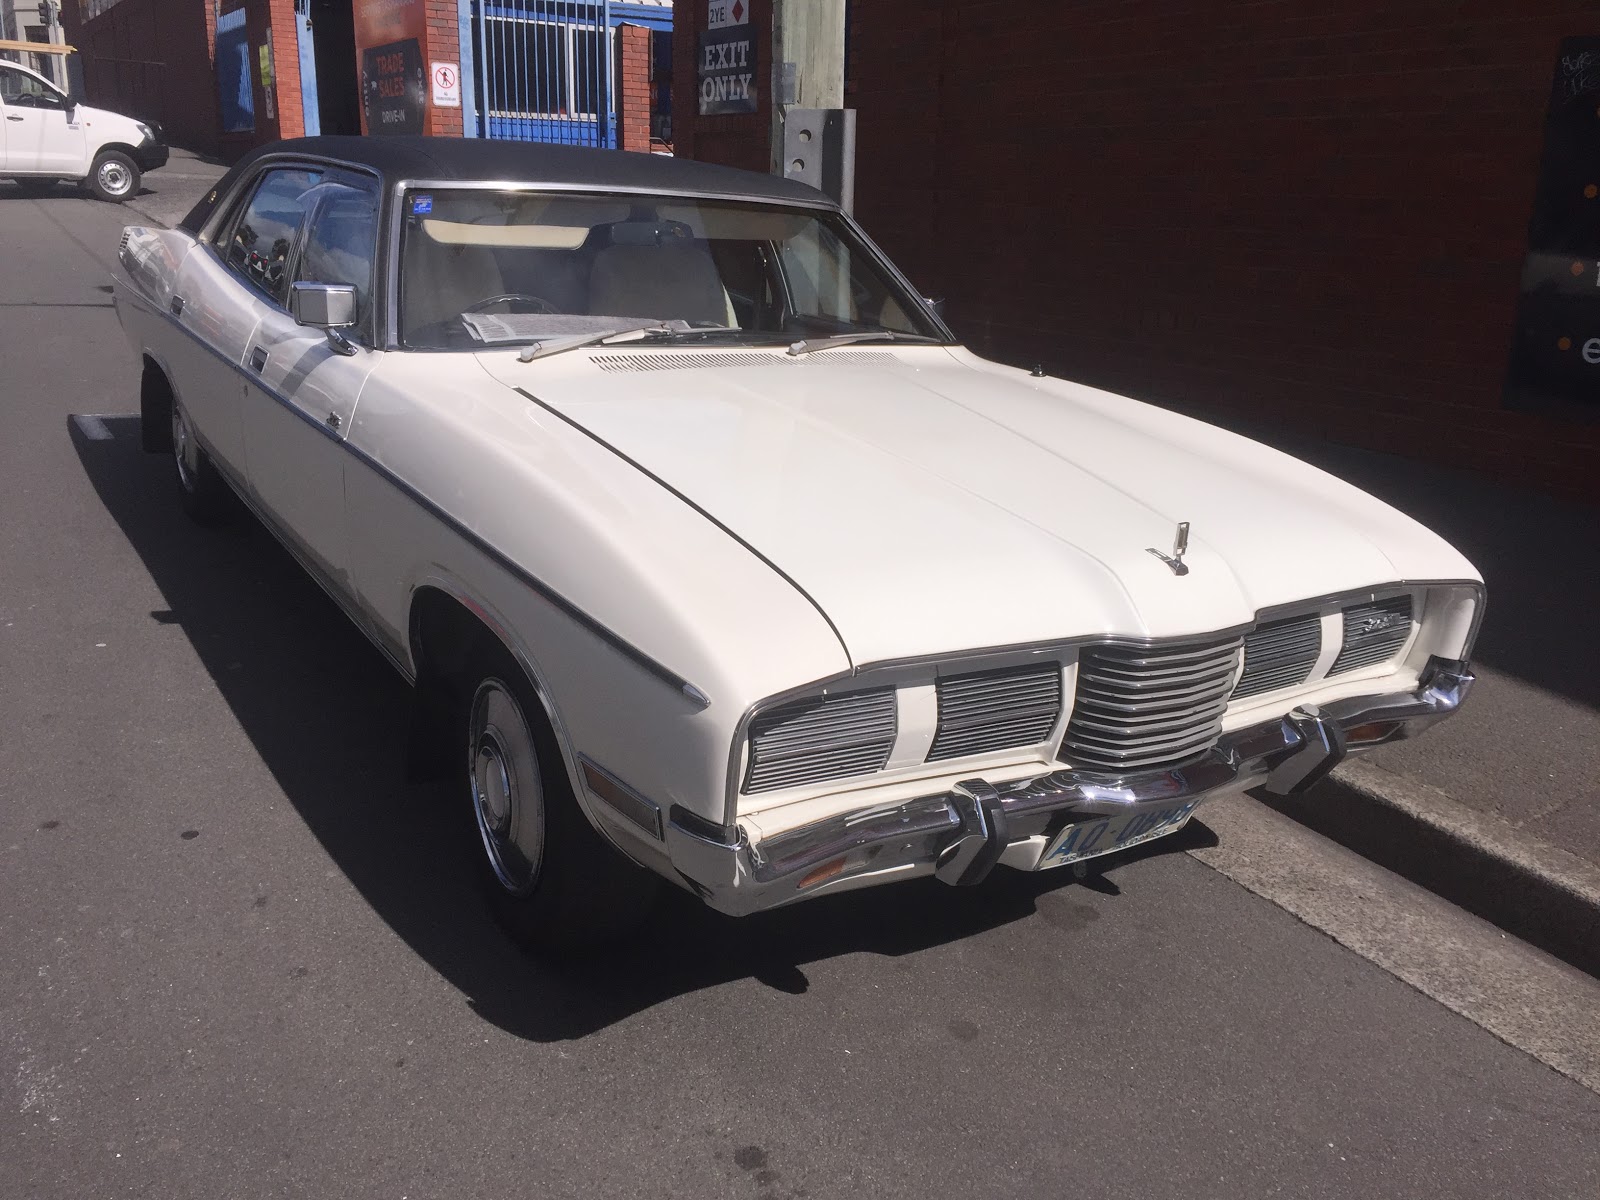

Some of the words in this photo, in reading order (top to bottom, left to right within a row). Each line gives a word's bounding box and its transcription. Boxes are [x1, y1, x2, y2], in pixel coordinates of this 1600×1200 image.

[710, 7, 724, 23] 2YE
[376, 52, 404, 74] TRADE
[704, 40, 750, 70] EXIT
[380, 77, 404, 97] SALES
[702, 73, 752, 102] ONLY
